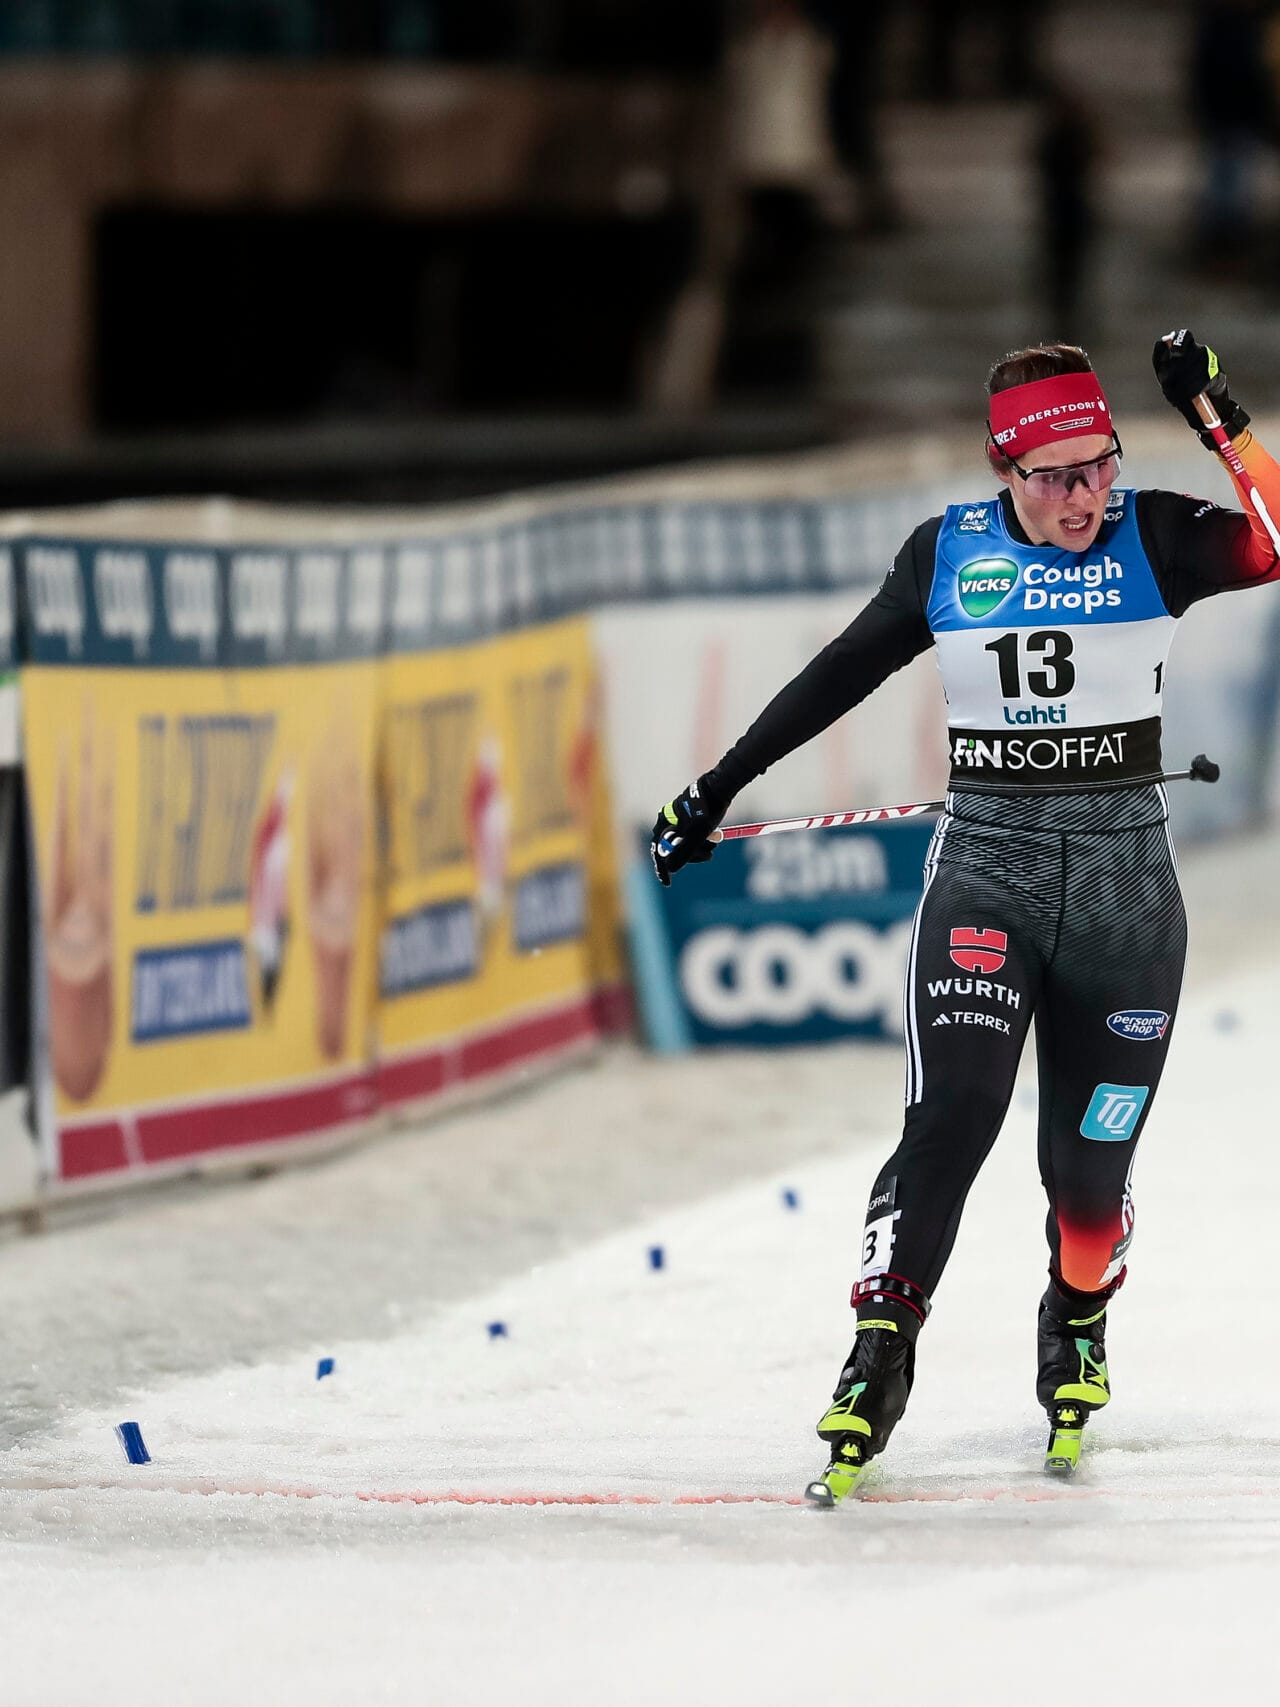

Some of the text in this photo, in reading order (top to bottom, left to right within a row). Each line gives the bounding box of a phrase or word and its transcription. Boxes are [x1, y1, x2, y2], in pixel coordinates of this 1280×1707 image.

[1019, 401, 1096, 426] OBERSTDORF
[1022, 556, 1123, 588] Cough
[961, 577, 1012, 595] VICKS
[1023, 588, 1122, 615] Drops
[984, 630, 1076, 699] 13
[1153, 661, 1165, 695] 1
[927, 978, 1021, 1010] WÜRTH
[951, 1011, 1011, 1036] TERREX
[1122, 1022, 1154, 1036] shop
